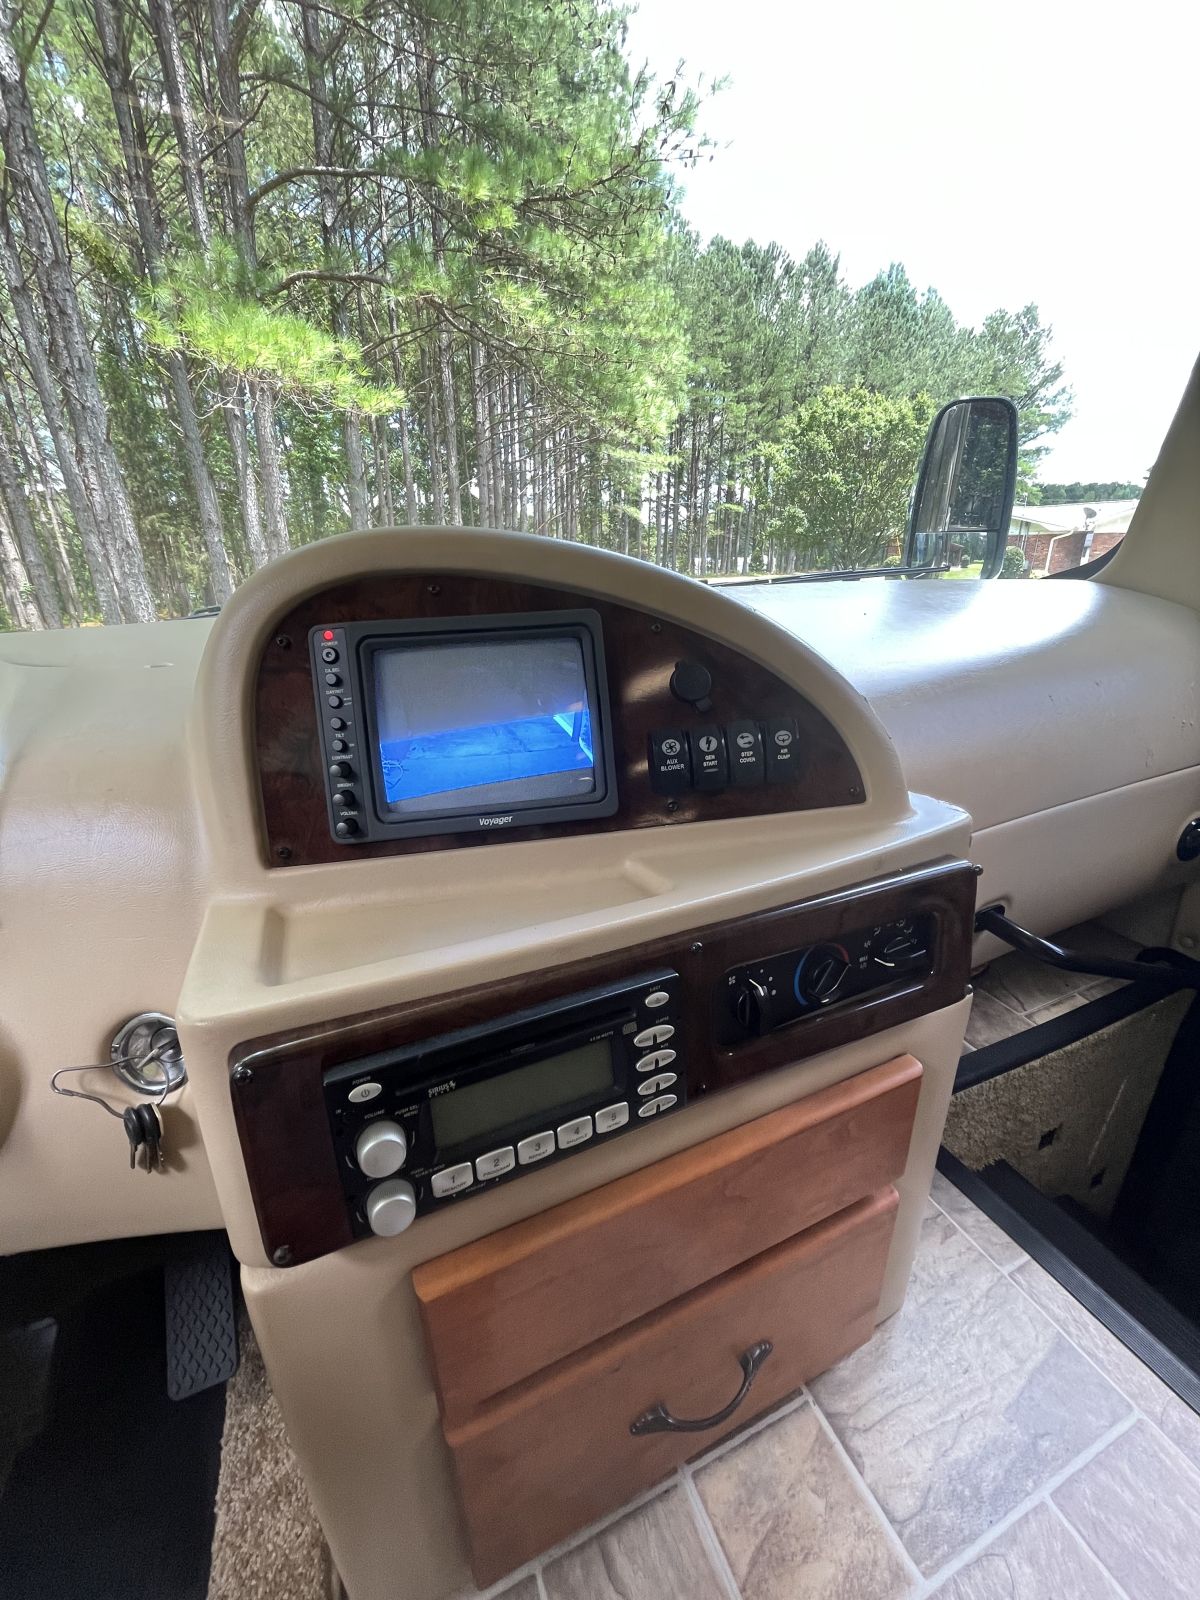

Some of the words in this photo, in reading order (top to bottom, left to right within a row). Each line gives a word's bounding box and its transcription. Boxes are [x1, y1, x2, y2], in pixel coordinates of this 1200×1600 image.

[479, 816, 514, 826] Voyager
[352, 1076, 370, 1085] POWER
[428, 1083, 449, 1094] SIRIUS
[364, 1109, 384, 1119] VOLUME
[611, 1113, 616, 1121] 5
[574, 1127, 580, 1136] 4
[534, 1142, 540, 1152] 3
[493, 1158, 500, 1168] 2
[451, 1175, 456, 1184] 1
[442, 1182, 466, 1193] MEMORY
